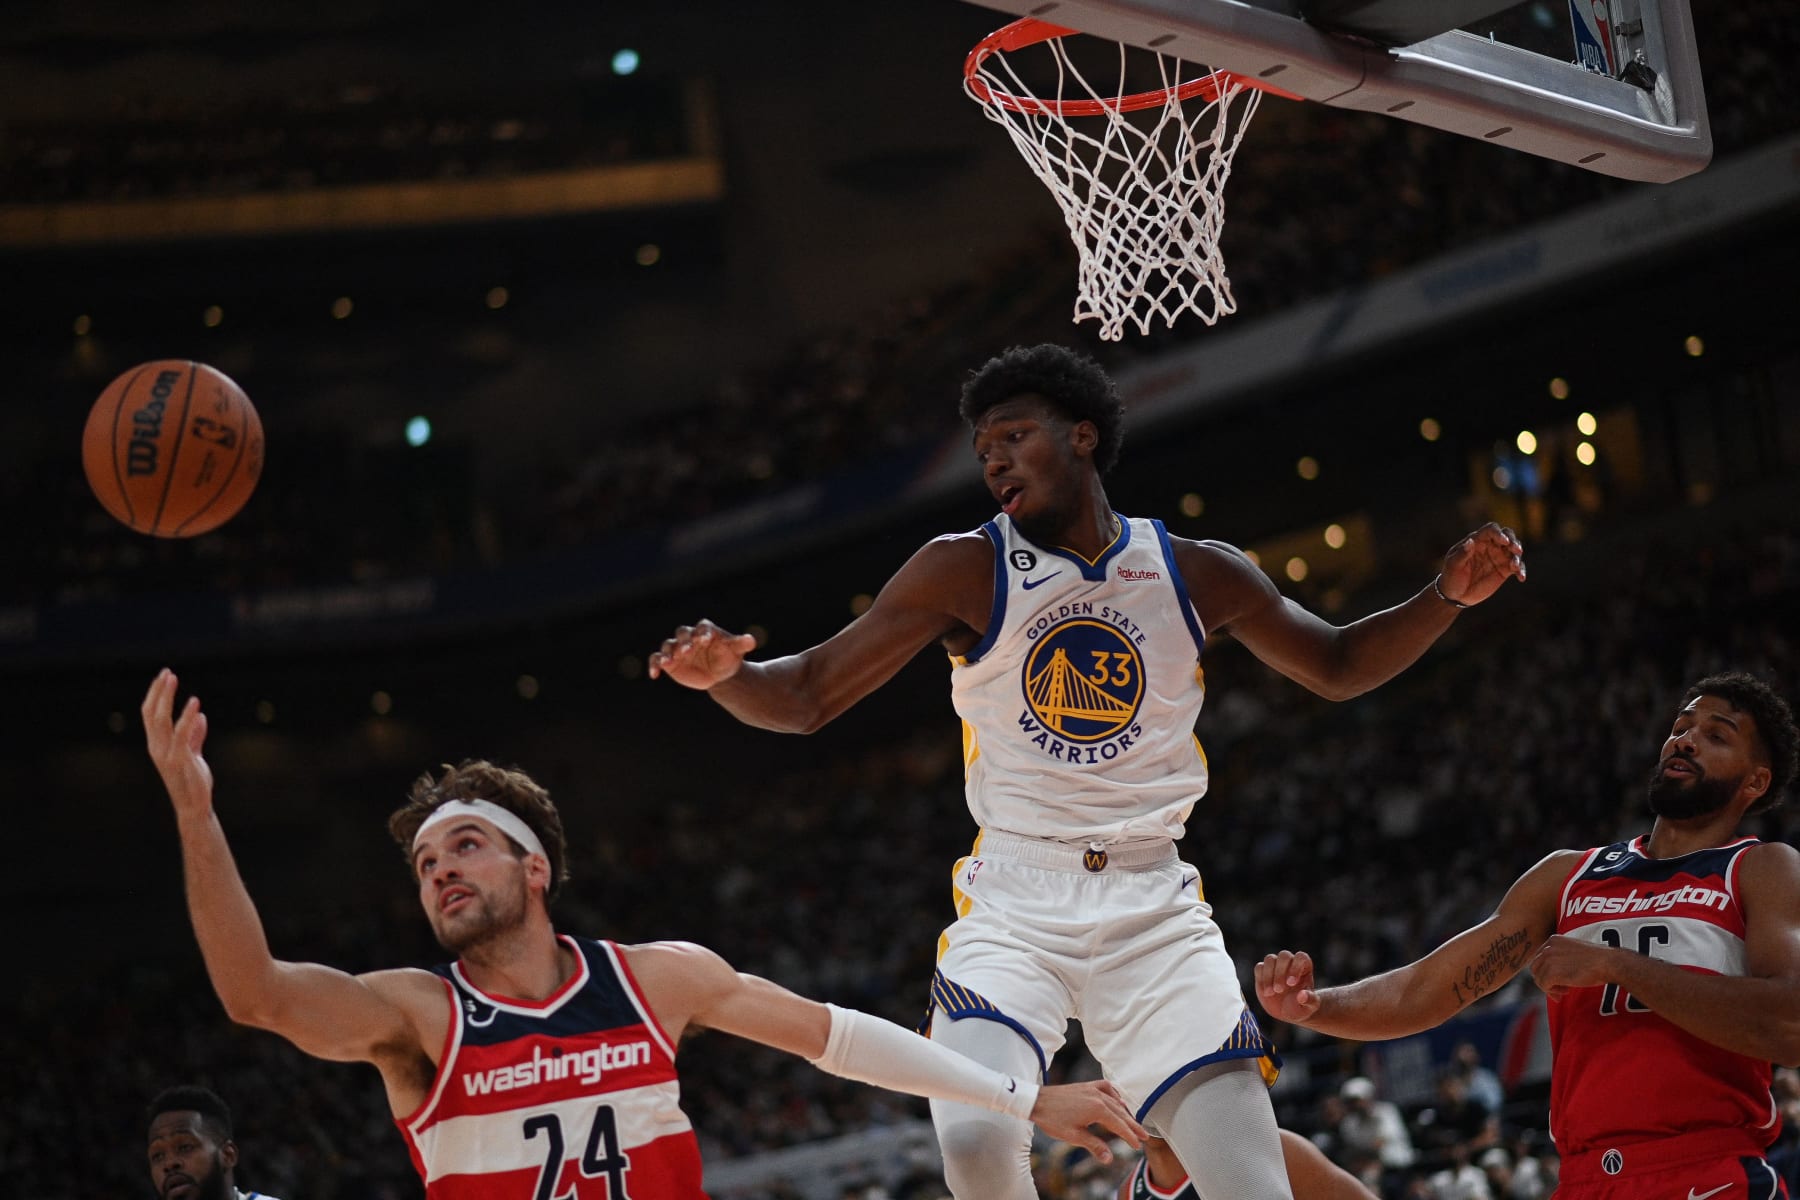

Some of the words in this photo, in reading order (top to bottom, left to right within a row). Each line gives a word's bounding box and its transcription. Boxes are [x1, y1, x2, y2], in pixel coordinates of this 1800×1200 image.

[1581, 42, 1602, 69] NBA
[127, 371, 181, 477] Wilson
[1014, 552, 1031, 569] 6
[1117, 567, 1160, 581] Rakuten
[1026, 602, 1093, 640] GOLDEN
[1101, 606, 1147, 646] STATE
[1089, 650, 1132, 687] 33
[1018, 709, 1142, 764] WARRIORS
[1084, 854, 1106, 869] W
[1605, 851, 1622, 861] 6
[1566, 884, 1731, 918] washington
[463, 1040, 650, 1097] washington
[522, 1104, 632, 1200] 24
